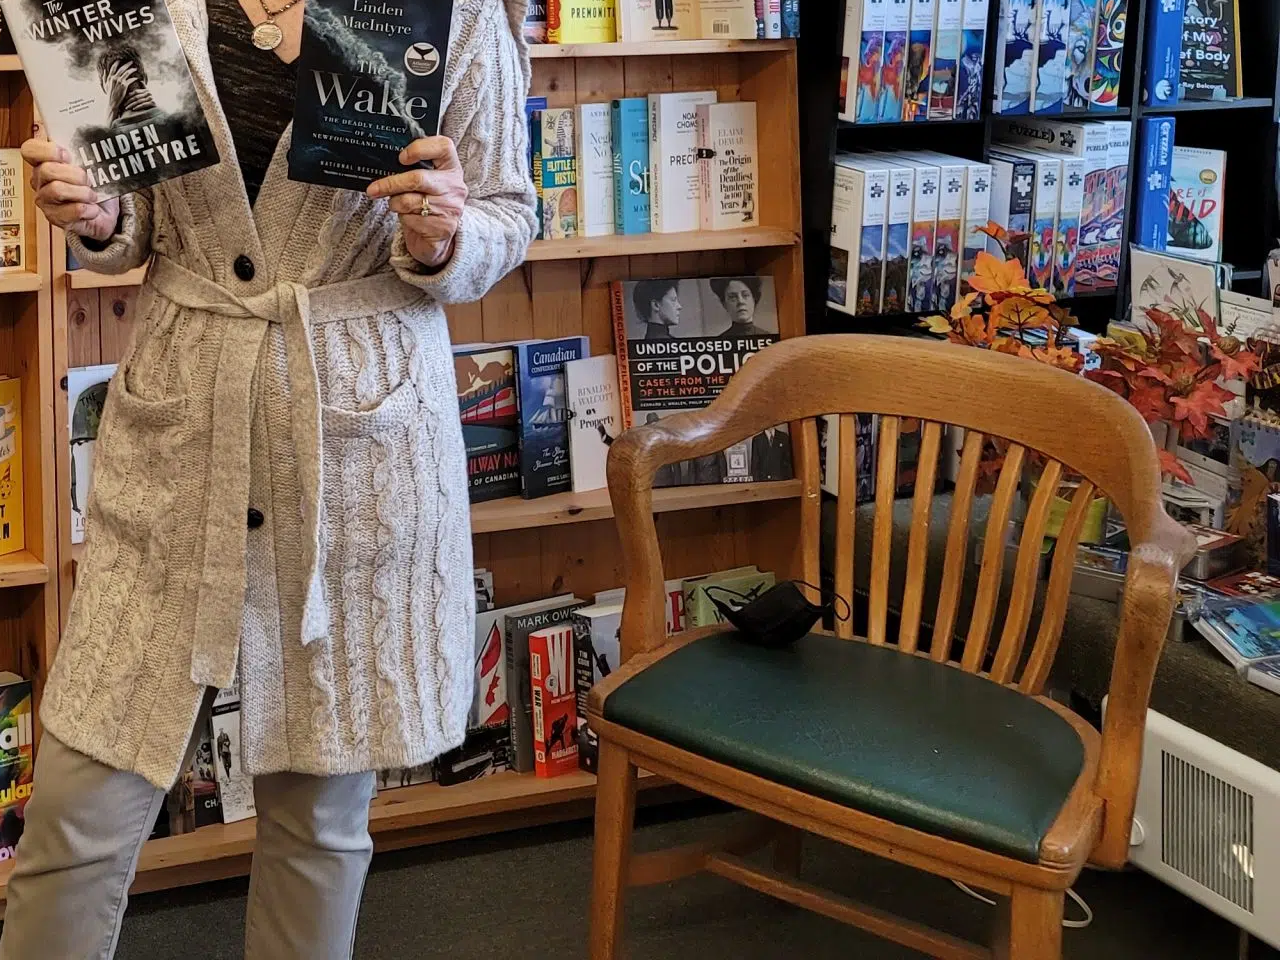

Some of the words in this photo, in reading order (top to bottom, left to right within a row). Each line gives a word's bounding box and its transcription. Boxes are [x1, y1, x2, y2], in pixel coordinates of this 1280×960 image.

[43, 0, 64, 16] The
[353, 0, 404, 16] Linden
[26, 0, 114, 40] WINTER
[82, 5, 155, 43] WIVES
[342, 15, 412, 36] MacIntyre
[1194, 32, 1214, 44] My
[1196, 49, 1230, 63] Body
[357, 60, 386, 75] The
[310, 69, 428, 120] Wake
[342, 119, 373, 128] DEADLY
[376, 124, 407, 134] LEGACY
[79, 124, 160, 167] LINDEN
[312, 133, 376, 147] NEWFOUNDLAND
[320, 160, 353, 171] NATIONAL
[728, 156, 752, 167] Origin
[719, 174, 753, 184] Deadliest
[719, 182, 755, 192] Pandemic
[720, 200, 740, 210] Years
[636, 340, 732, 354] UNDISCLOSED
[532, 347, 576, 365] Canadian
[637, 362, 652, 371] OF
[658, 361, 678, 370] THE
[579, 414, 615, 429] Property
[517, 612, 550, 629] MARK
